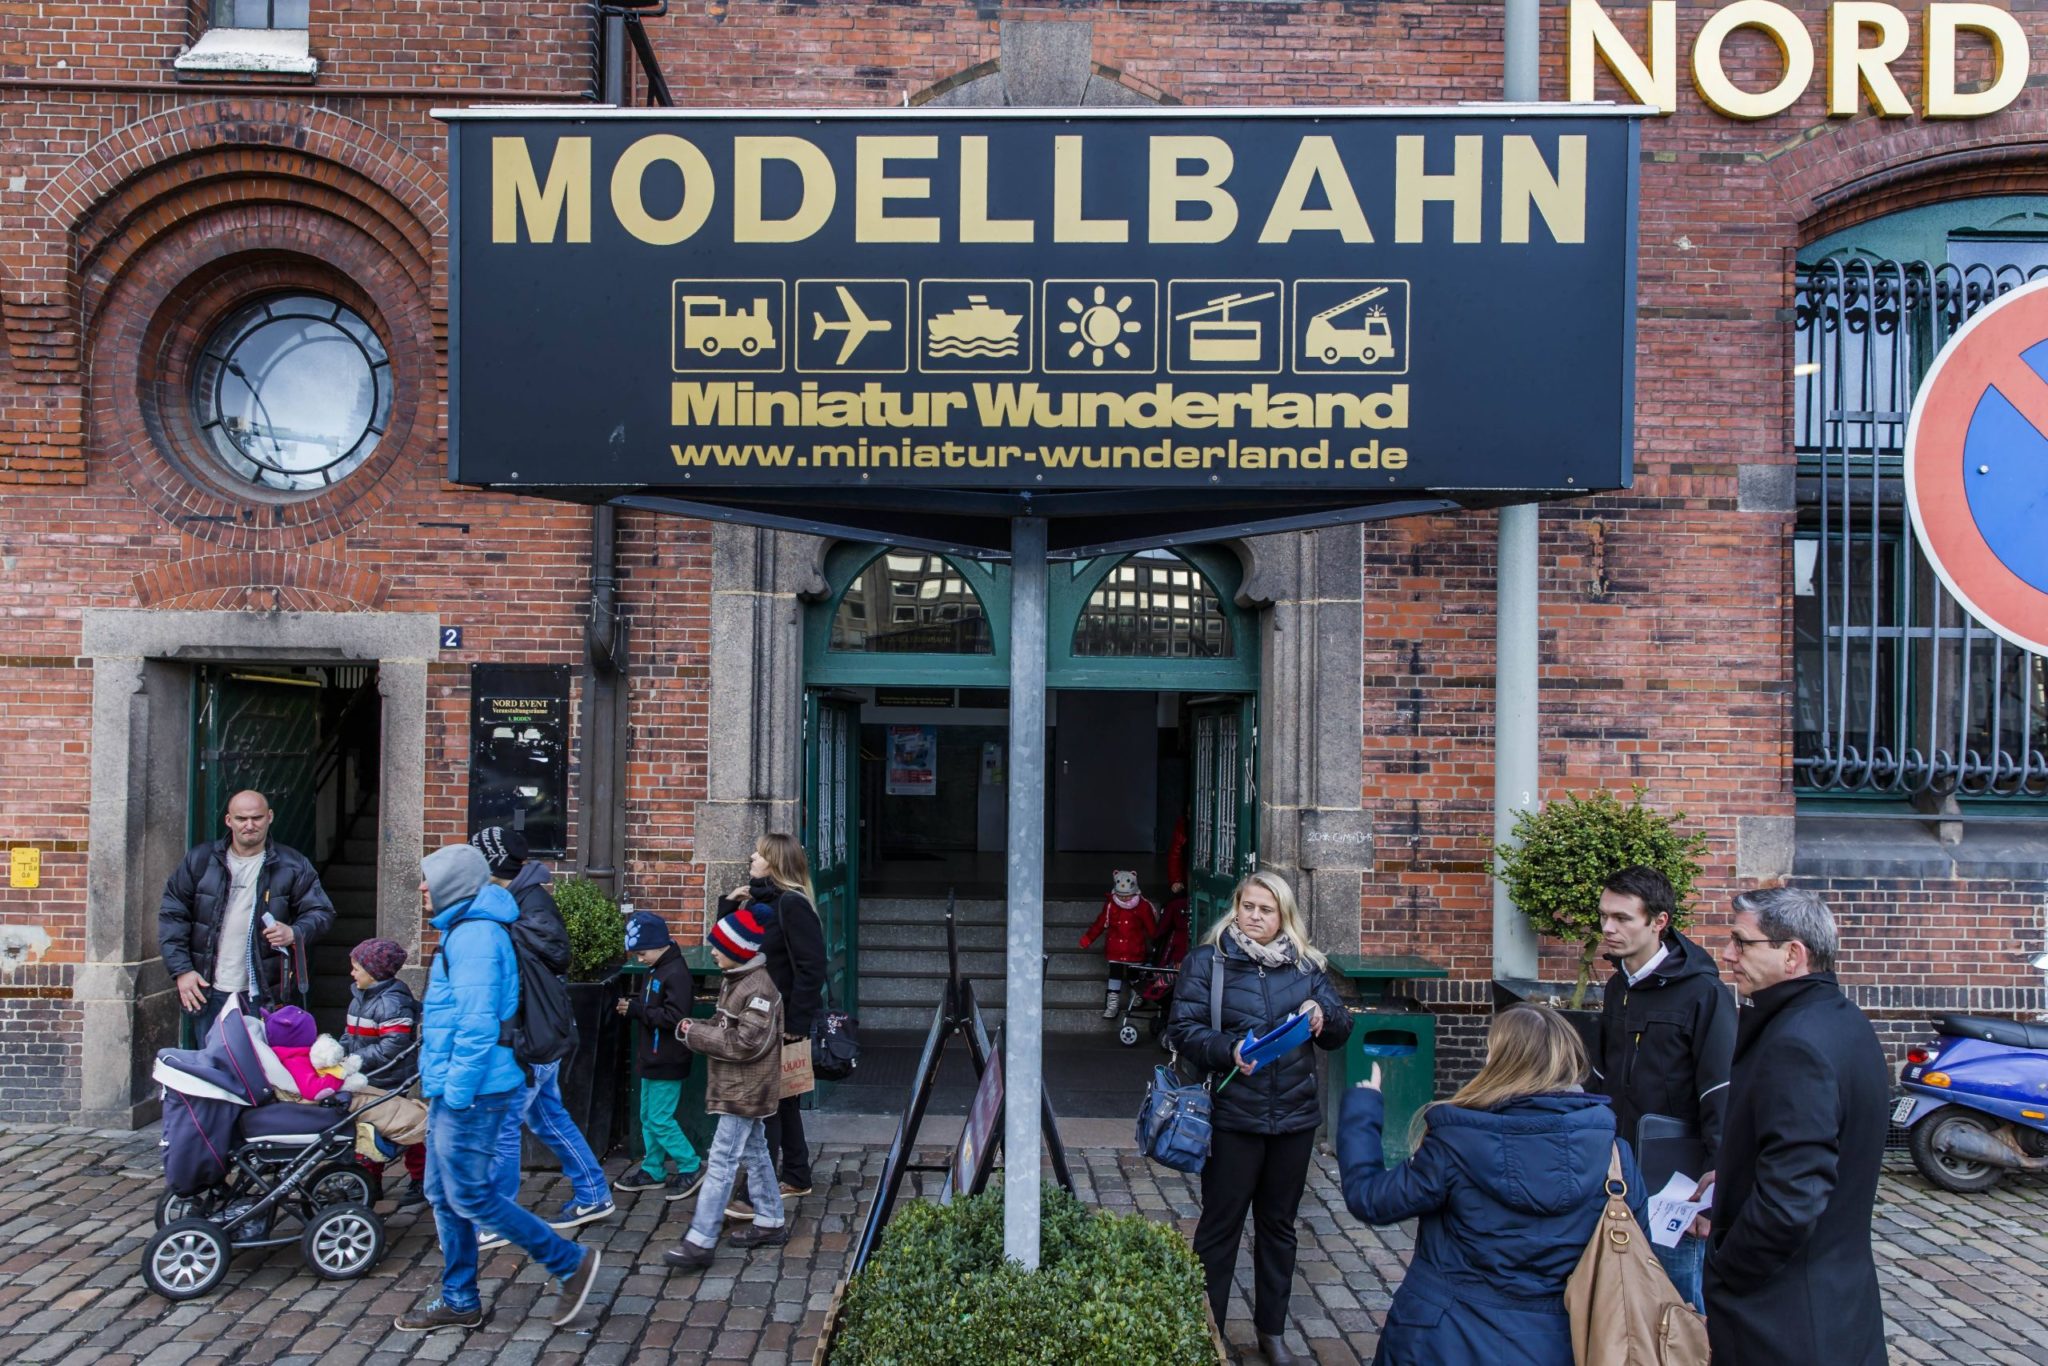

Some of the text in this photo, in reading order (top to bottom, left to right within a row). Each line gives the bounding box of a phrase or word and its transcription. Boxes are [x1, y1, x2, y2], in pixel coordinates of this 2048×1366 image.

[1569, 0, 2030, 120] NORD
[492, 134, 1587, 246] MODELLBAHN
[670, 382, 1409, 429] Miniatur Wunderland
[671, 438, 1408, 470] www.miniatur-wunderland.de
[445, 628, 457, 647] 2
[492, 699, 548, 708] NORD EVENT
[1522, 791, 1530, 805] 3
